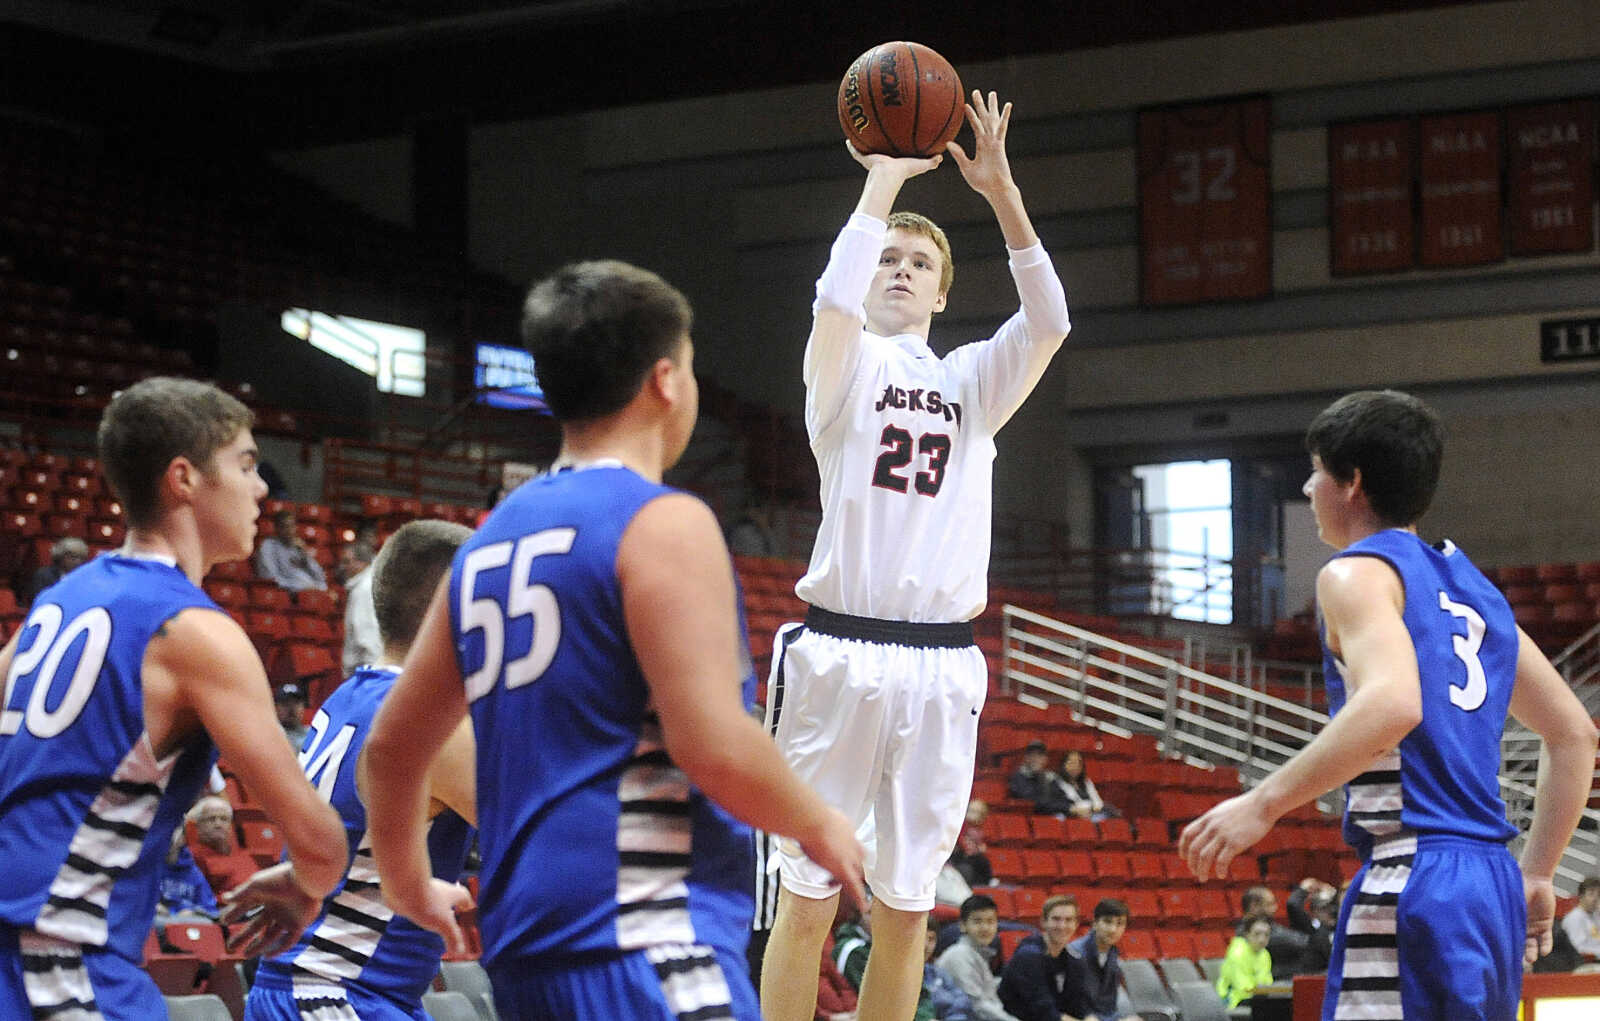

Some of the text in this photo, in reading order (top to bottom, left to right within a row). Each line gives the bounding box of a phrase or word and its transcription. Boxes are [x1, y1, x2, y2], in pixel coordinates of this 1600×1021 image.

[880, 53, 902, 107] NCAA
[1171, 147, 1238, 205] 32
[1551, 325, 1600, 357] 11
[872, 423, 952, 498] 23
[460, 527, 578, 703] 55
[1438, 590, 1488, 711] 3
[0, 603, 112, 738] 20
